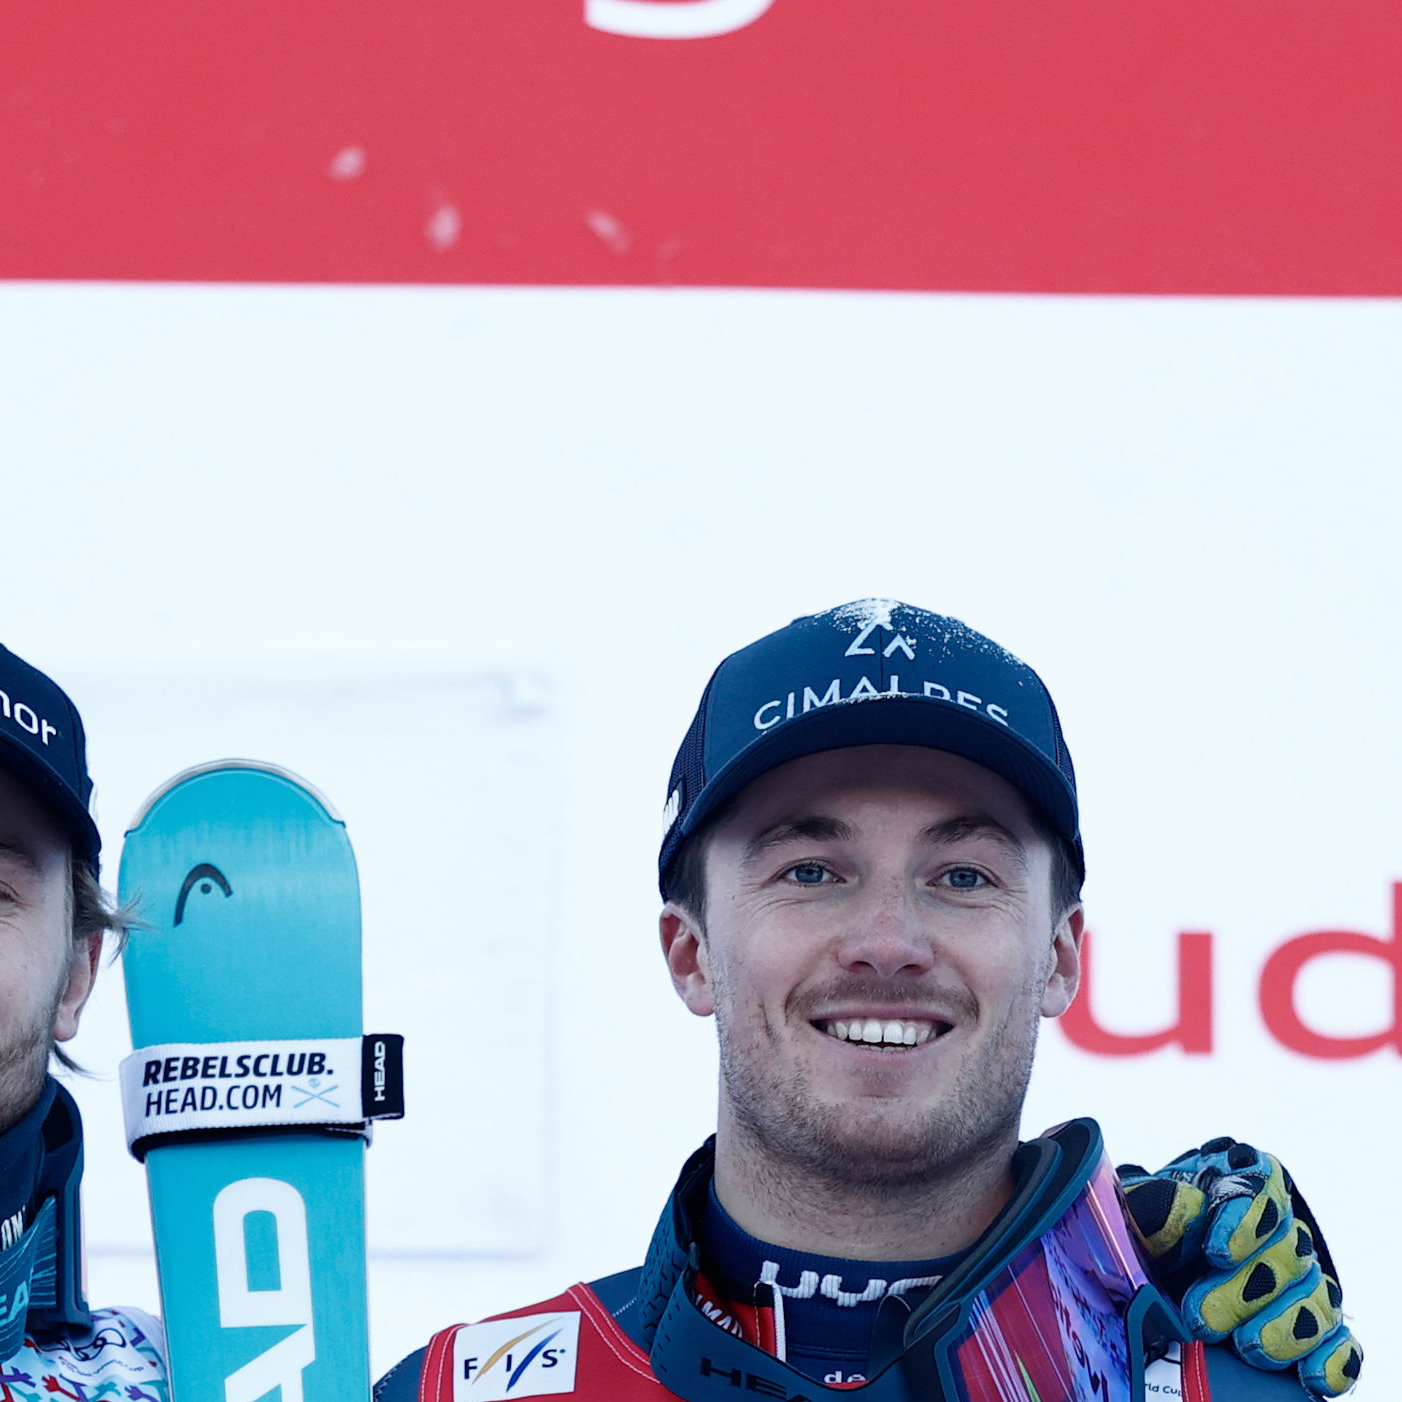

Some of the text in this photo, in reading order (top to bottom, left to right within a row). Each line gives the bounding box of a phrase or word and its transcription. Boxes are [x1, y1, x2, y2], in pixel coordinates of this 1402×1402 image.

[142, 1052, 334, 1087] REBELSCLUB.
[374, 1041, 386, 1101] HEAD
[145, 1084, 282, 1118] HEAD.COM
